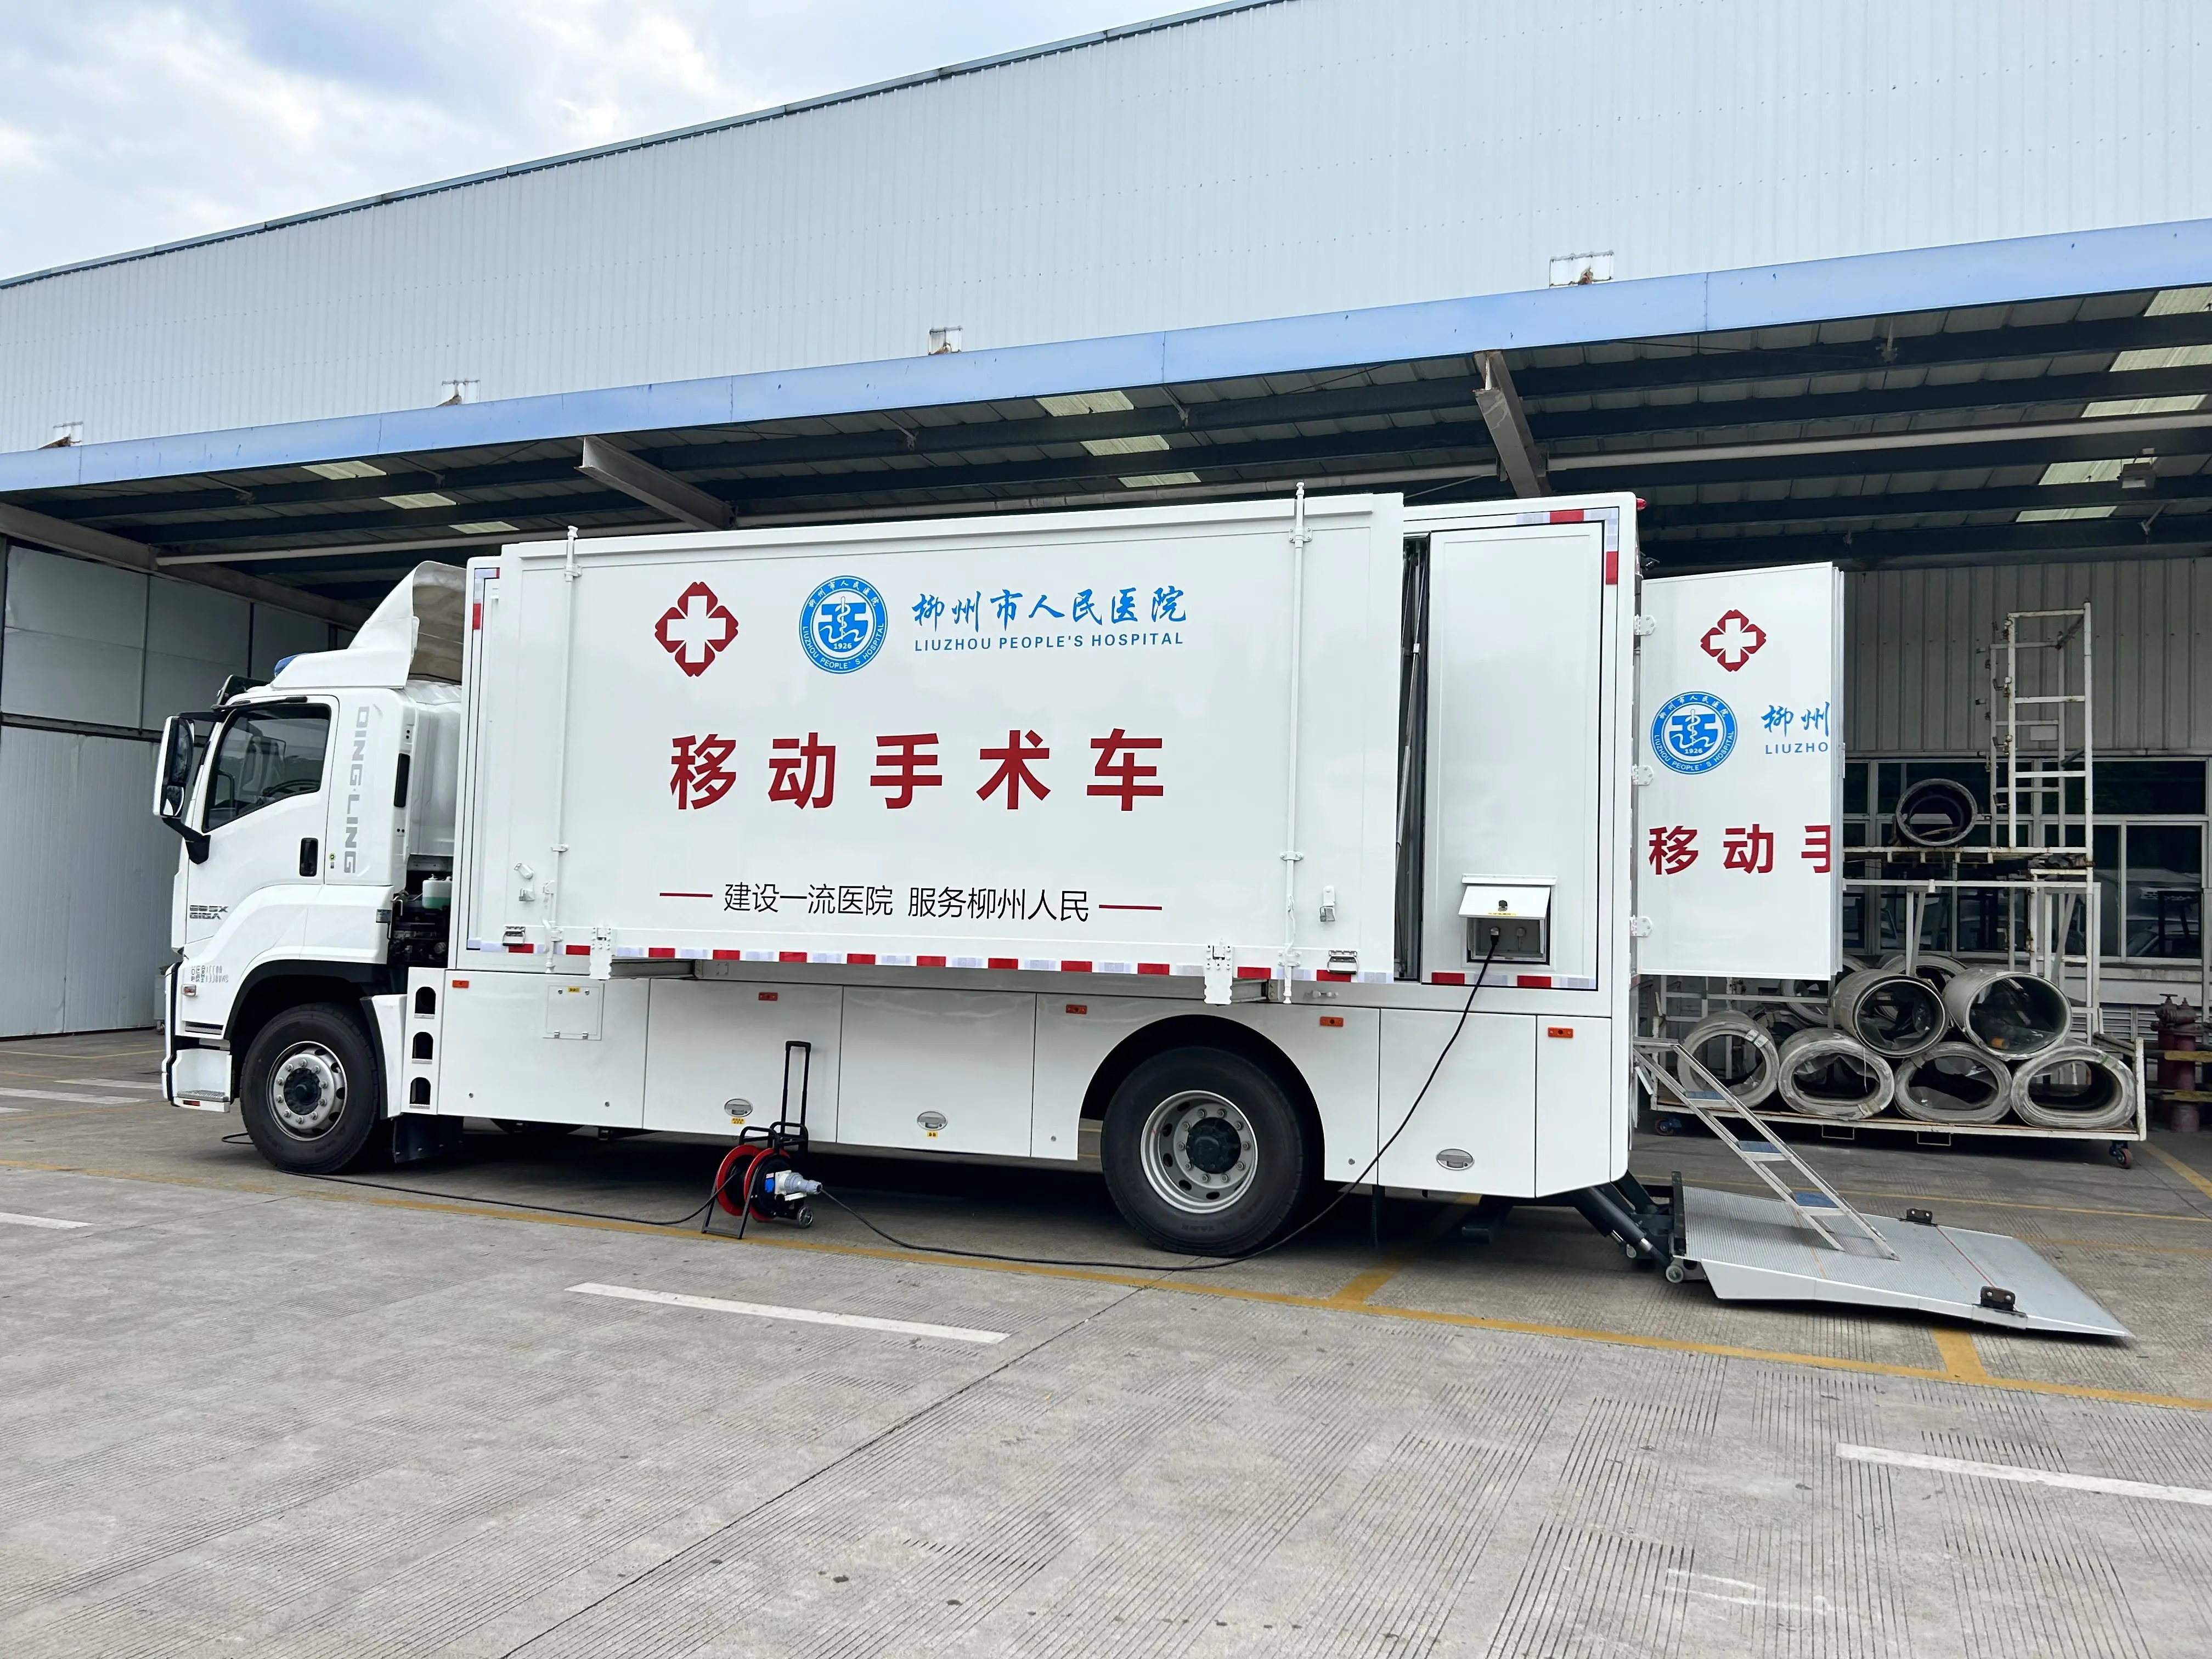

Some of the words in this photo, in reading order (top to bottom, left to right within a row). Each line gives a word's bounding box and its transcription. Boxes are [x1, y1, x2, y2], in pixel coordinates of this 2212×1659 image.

[808, 580, 879, 608] 柳州市人民医院
[912, 585, 1187, 633] 柳州市人民医院
[803, 626, 819, 658] LIUZHOU
[864, 623, 884, 660] HOSPITAL
[915, 637, 991, 652] LIUZHOU
[999, 635, 1084, 649] PEOPLE'S
[1091, 632, 1184, 647] HOSPITAL
[1654, 735, 1671, 763] LIUZHOU
[1714, 731, 1734, 763] HOSPITAL
[1765, 742, 1829, 754] LIUZHO
[670, 727, 1164, 811] 移动手术车
[724, 882, 893, 916] 建设一流医院
[907, 885, 1089, 922] 服务柳州人民
